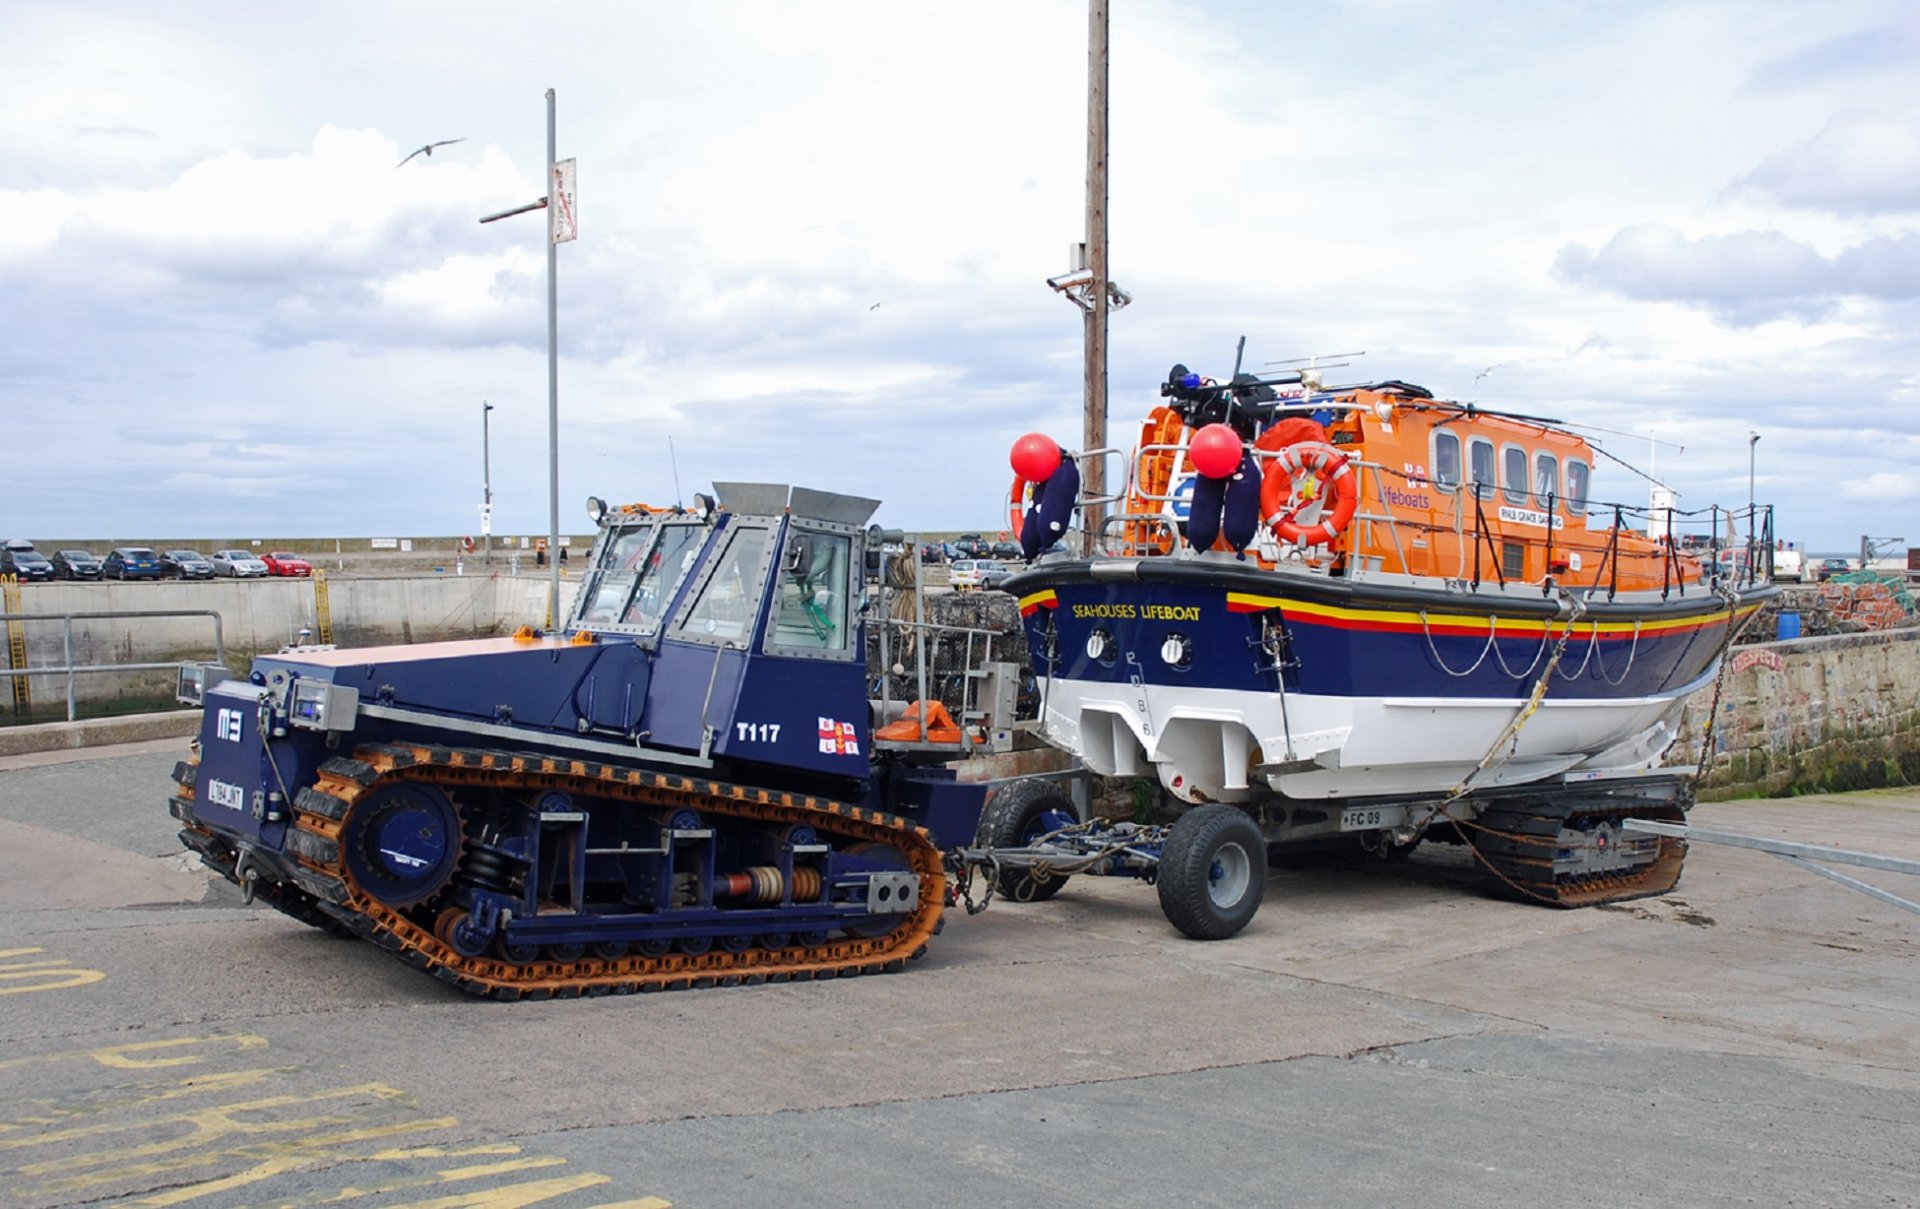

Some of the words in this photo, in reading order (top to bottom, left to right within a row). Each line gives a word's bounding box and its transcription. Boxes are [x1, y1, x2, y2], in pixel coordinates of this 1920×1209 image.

[1518, 511, 1537, 523] GRACE
[1072, 604, 1136, 619] SEAHOUSES
[1140, 604, 1200, 621] LIFEBOAT
[1137, 699, 1146, 713] 8
[217, 707, 243, 743] M3
[736, 722, 781, 743] T117
[1142, 723, 1151, 736] 6
[1350, 812, 1365, 826] FC
[1367, 811, 1381, 825] 09
